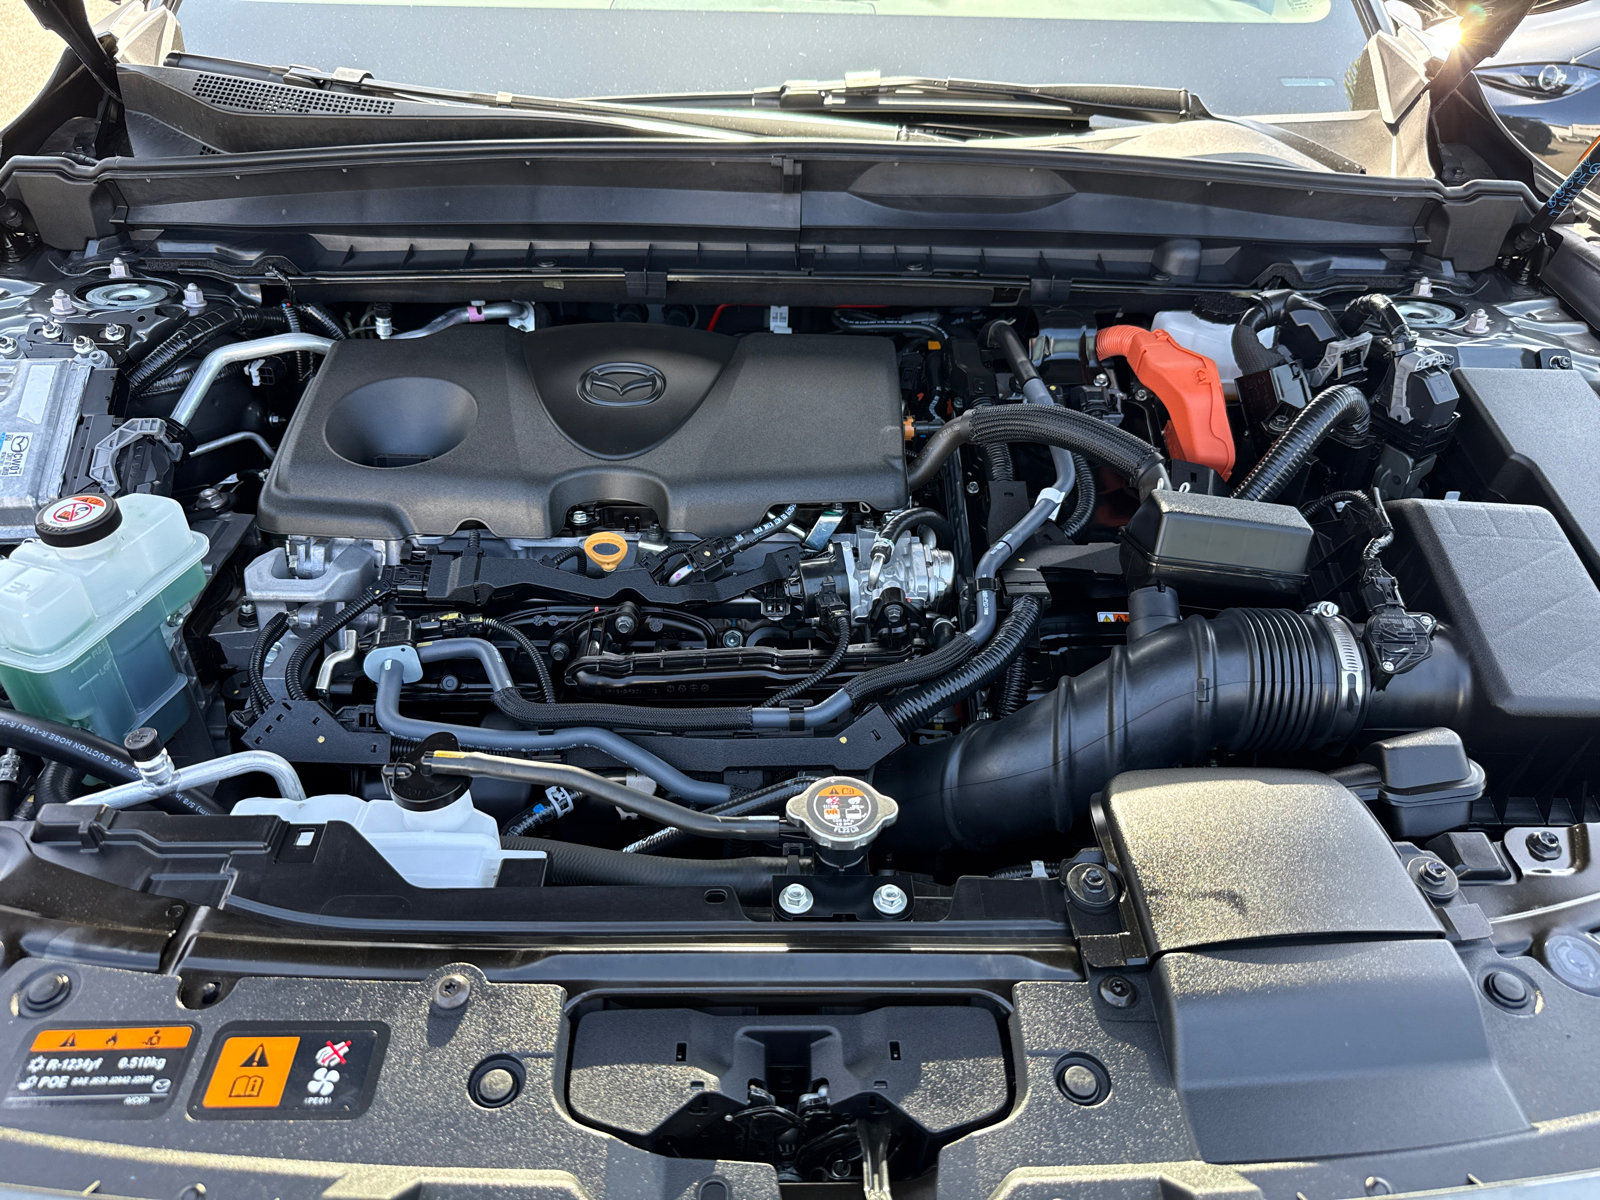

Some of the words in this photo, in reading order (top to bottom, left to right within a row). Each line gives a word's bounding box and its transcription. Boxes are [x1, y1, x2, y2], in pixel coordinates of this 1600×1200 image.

[22, 724, 49, 738] R-134a
[48, 732, 73, 747] HOSE
[72, 741, 111, 762] SUCTION
[111, 759, 127, 769] A/C
[46, 1057, 104, 1073] R-1234yf
[117, 1056, 167, 1071] 0.510kg
[38, 1075, 71, 1089] POE
